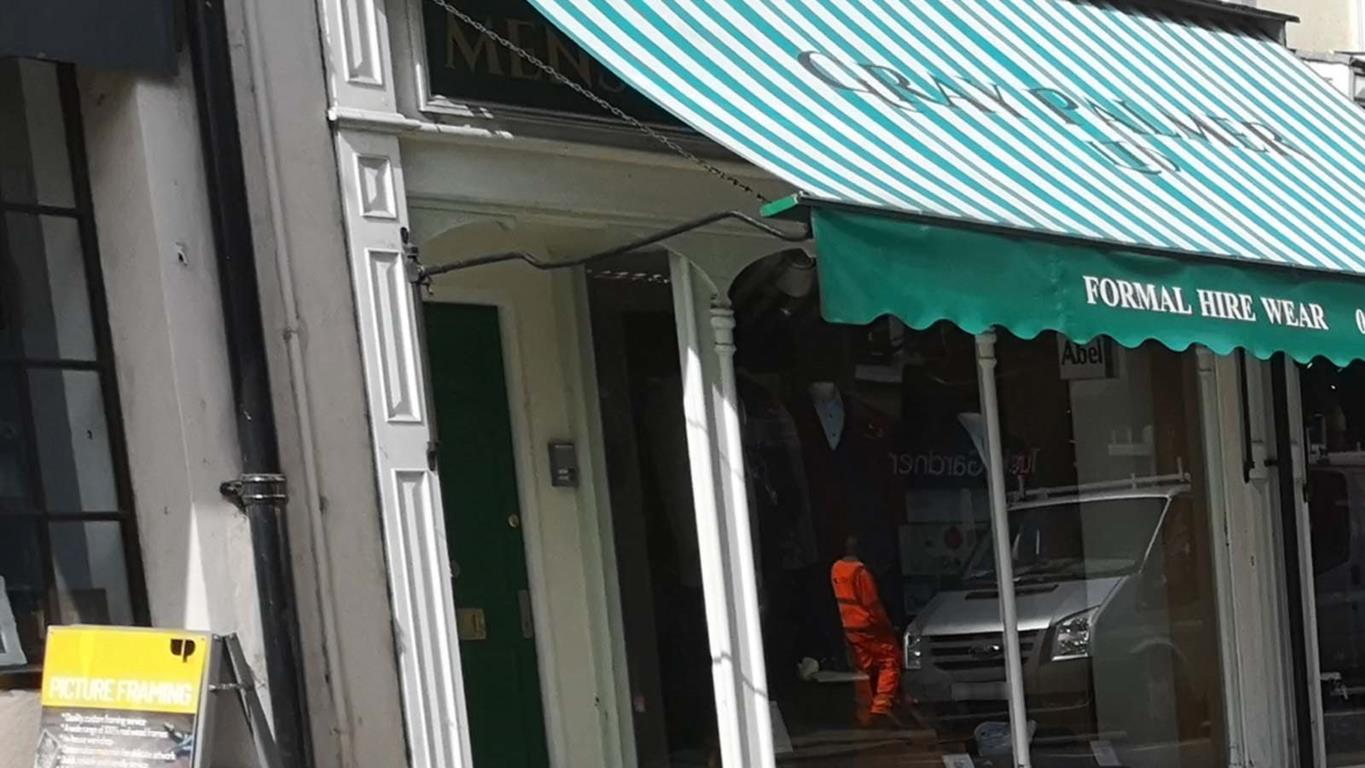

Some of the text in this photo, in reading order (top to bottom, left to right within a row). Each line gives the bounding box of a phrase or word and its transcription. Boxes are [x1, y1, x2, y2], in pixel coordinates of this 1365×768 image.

[1083, 275, 1192, 315] FORMAL
[1197, 288, 1256, 322] HIRE
[1260, 296, 1328, 331] WEAR
[51, 677, 193, 706] PICTURE FRAMING
